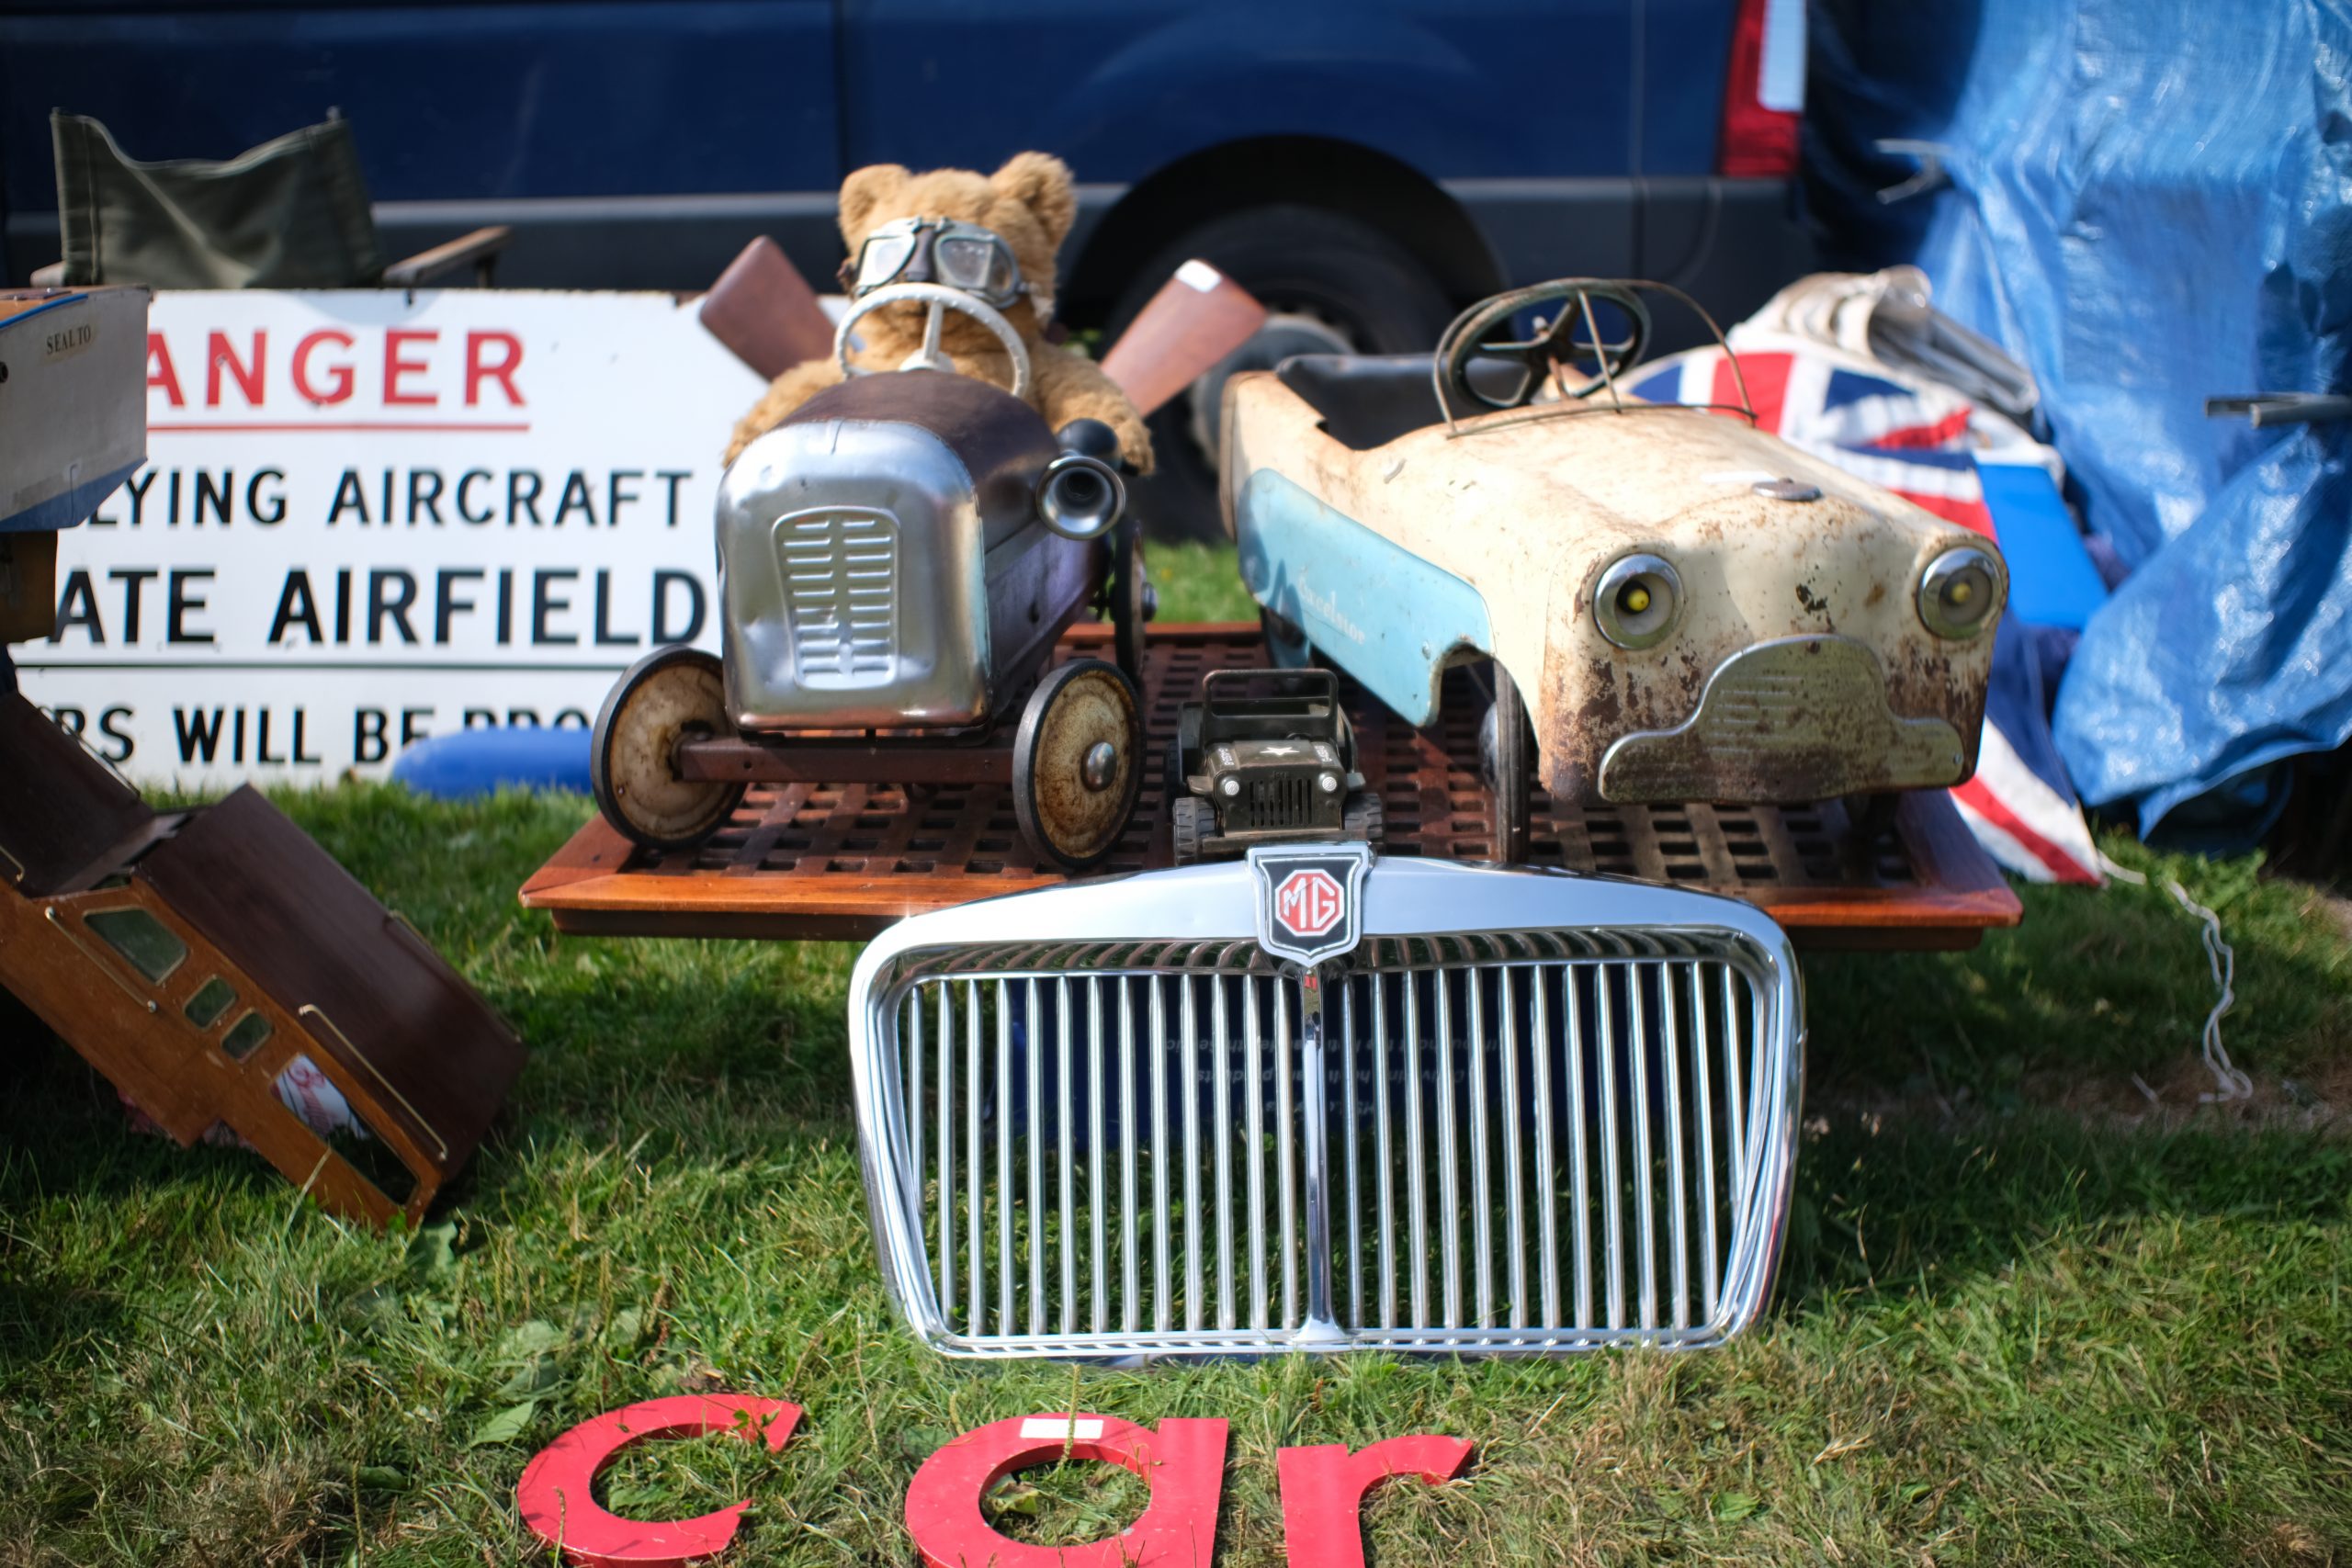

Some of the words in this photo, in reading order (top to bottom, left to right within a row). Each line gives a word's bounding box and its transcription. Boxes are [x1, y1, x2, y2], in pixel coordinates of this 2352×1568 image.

[46, 332, 74, 354] SEAL
[327, 469, 693, 526] AIRCRAFT
[46, 569, 218, 644] ATE
[266, 569, 707, 646] AIRFIELD
[174, 708, 322, 764] WILL
[1283, 877, 1336, 929] MG
